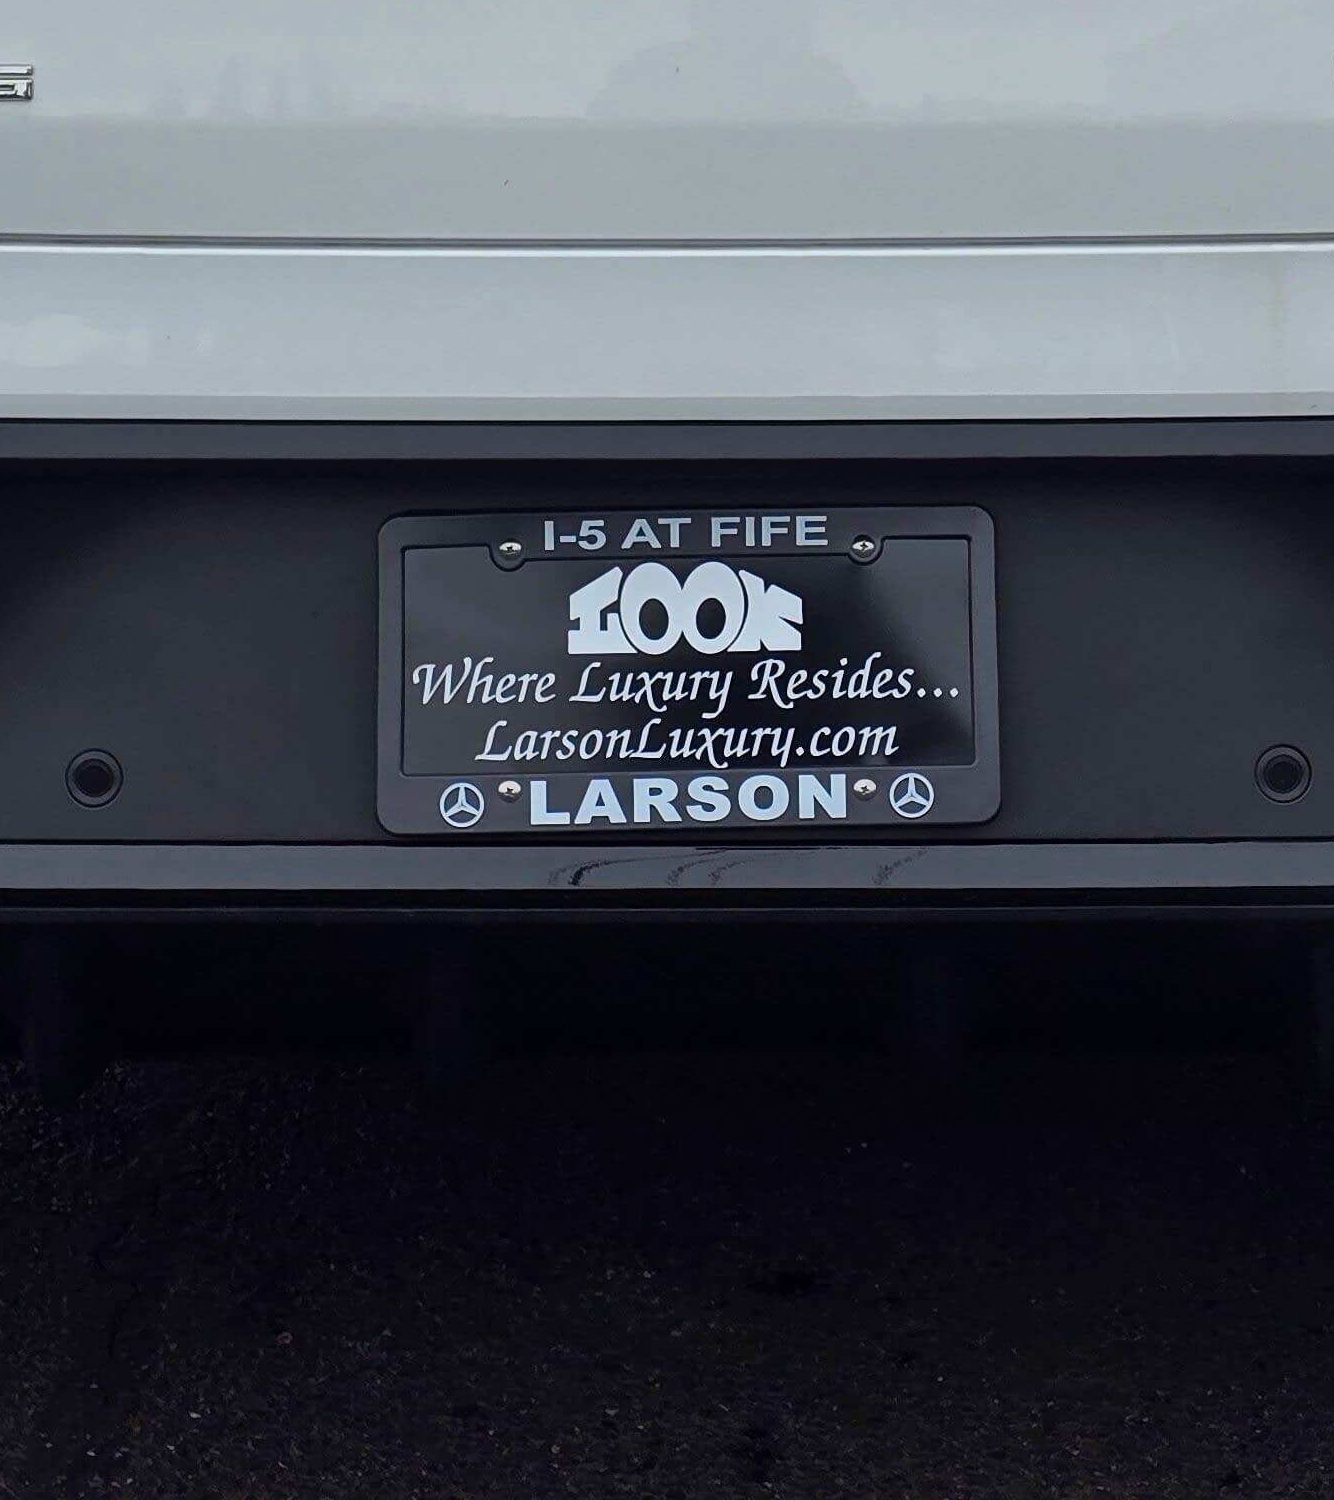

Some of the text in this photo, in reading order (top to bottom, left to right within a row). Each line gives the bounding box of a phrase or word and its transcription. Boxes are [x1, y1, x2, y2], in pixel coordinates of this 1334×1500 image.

[544, 515, 829, 551] I-5 AT FIFE
[412, 651, 960, 719] Where Luxury Resides...
[474, 717, 900, 769] LarsonLuxury.com
[529, 773, 847, 826] LARSON
